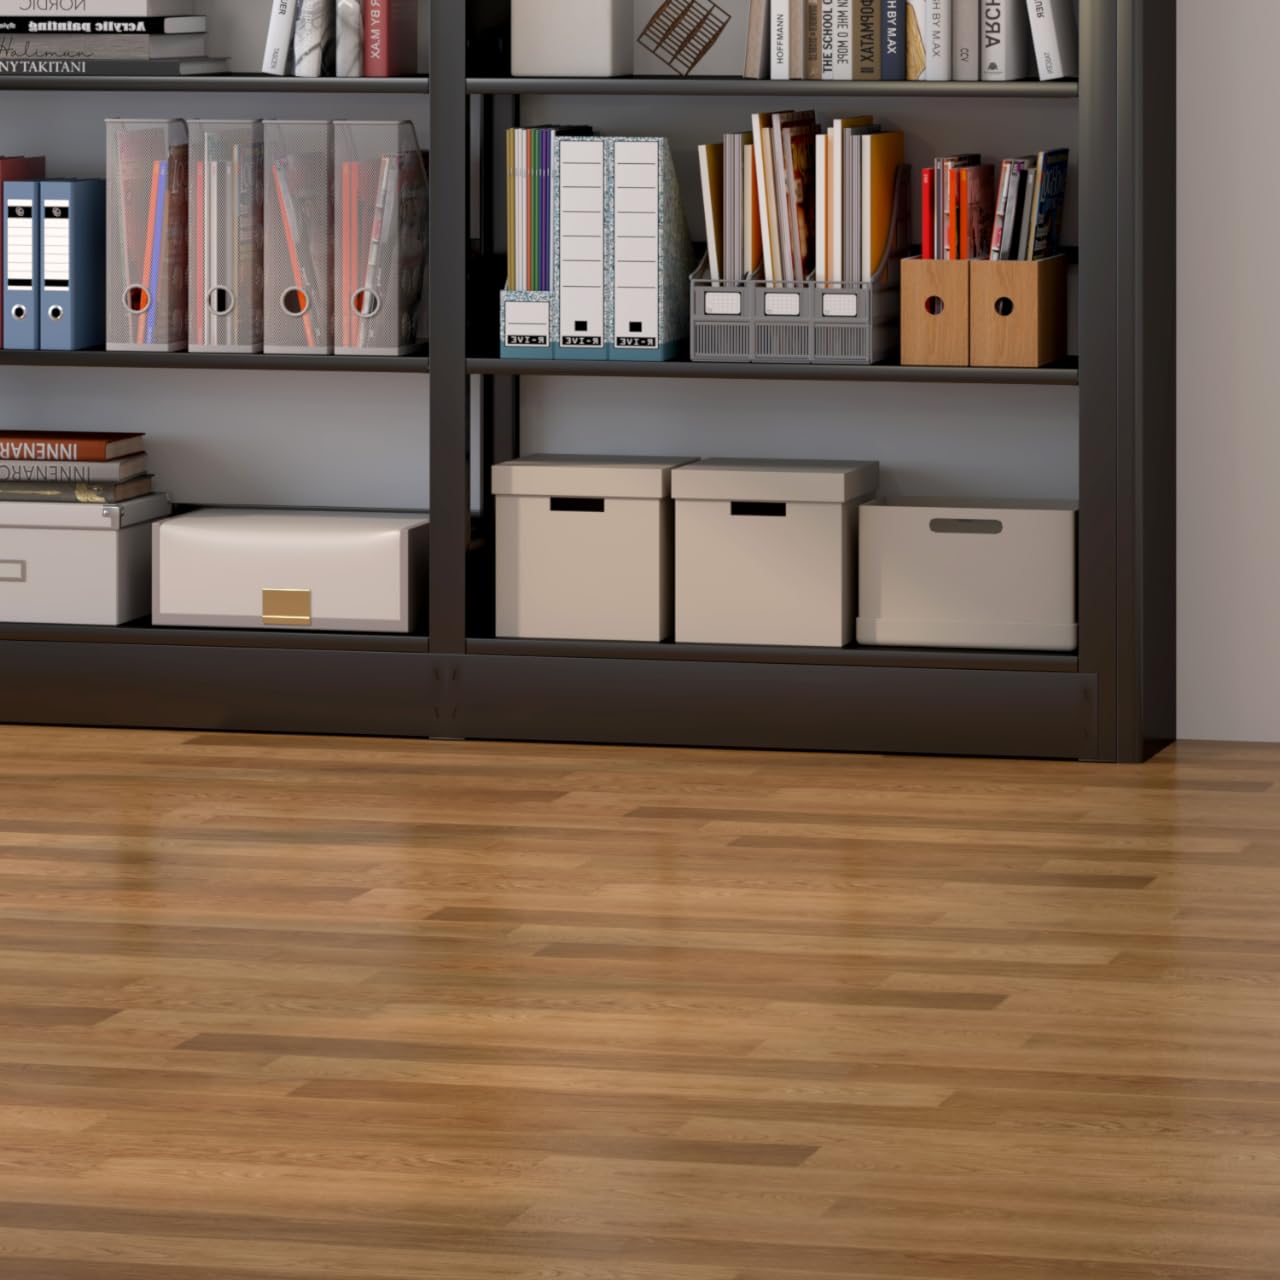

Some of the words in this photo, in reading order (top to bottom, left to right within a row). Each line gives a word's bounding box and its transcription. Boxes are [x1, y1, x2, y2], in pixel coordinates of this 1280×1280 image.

[887, 11, 897, 25] BY
[931, 12, 941, 27] BY
[822, 8, 833, 50] SCHOOL
[887, 26, 897, 54] M.AX
[931, 29, 941, 57] M.AX
[20, 61, 86, 73] TAKITANI
[822, 53, 833, 73] THE
